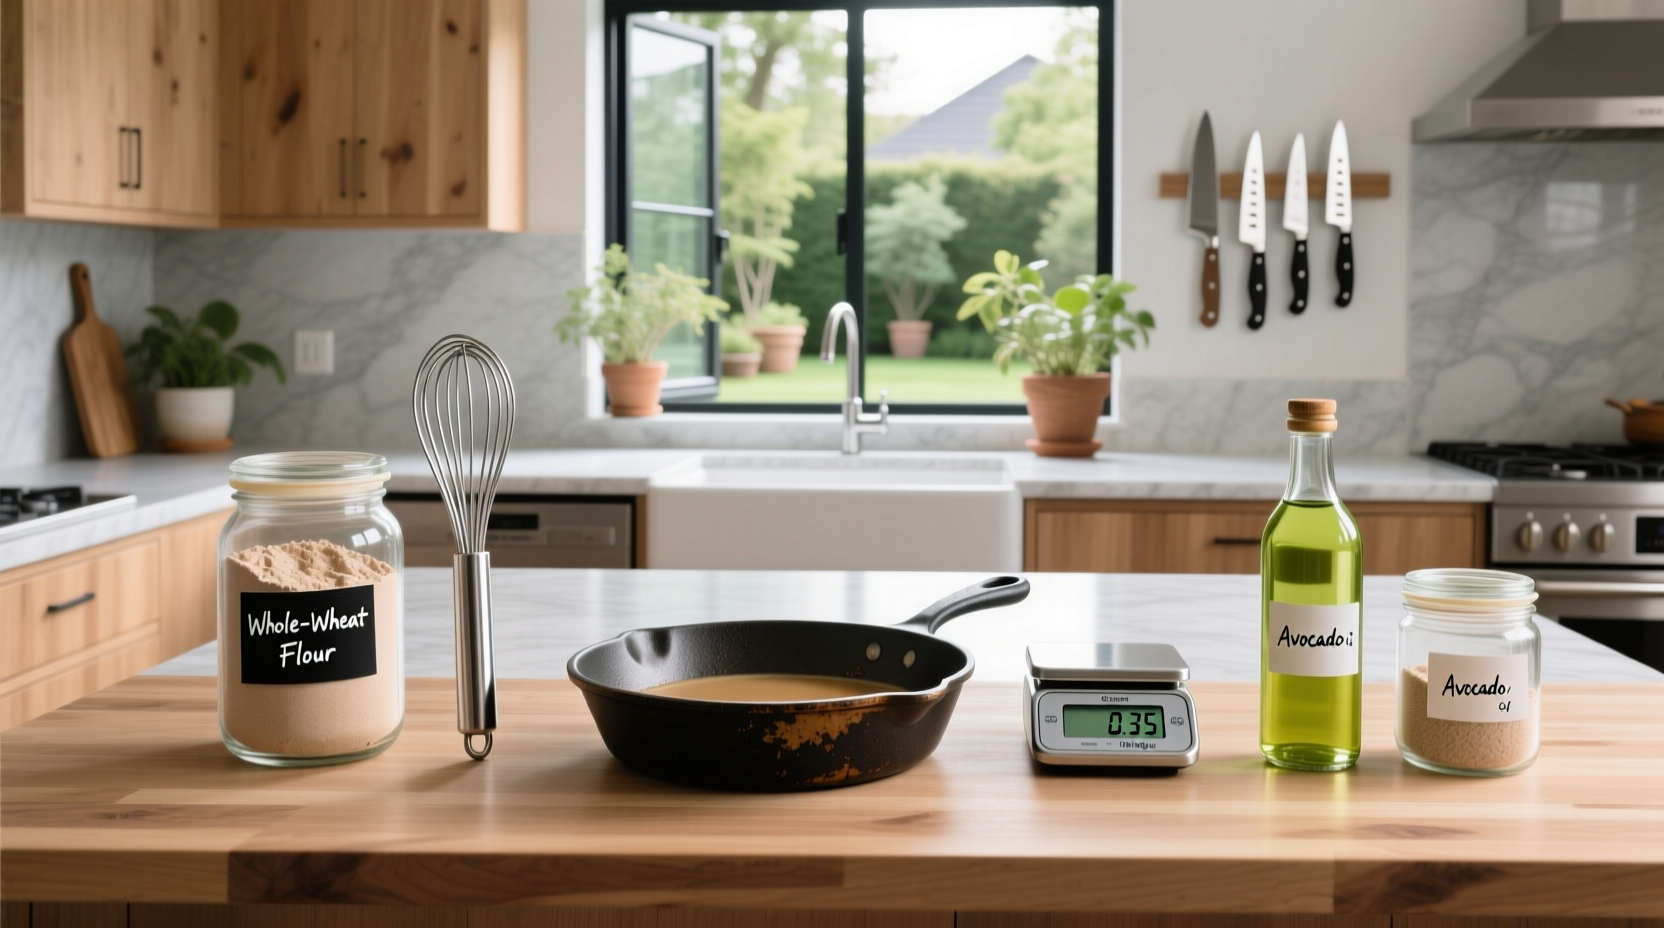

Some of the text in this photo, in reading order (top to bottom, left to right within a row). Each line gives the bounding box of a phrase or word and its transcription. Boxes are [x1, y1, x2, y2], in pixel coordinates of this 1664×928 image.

[248, 606, 369, 636] Whole-Wheat
[279, 640, 337, 668] Flour
[1107, 712, 1157, 736] 0.35
